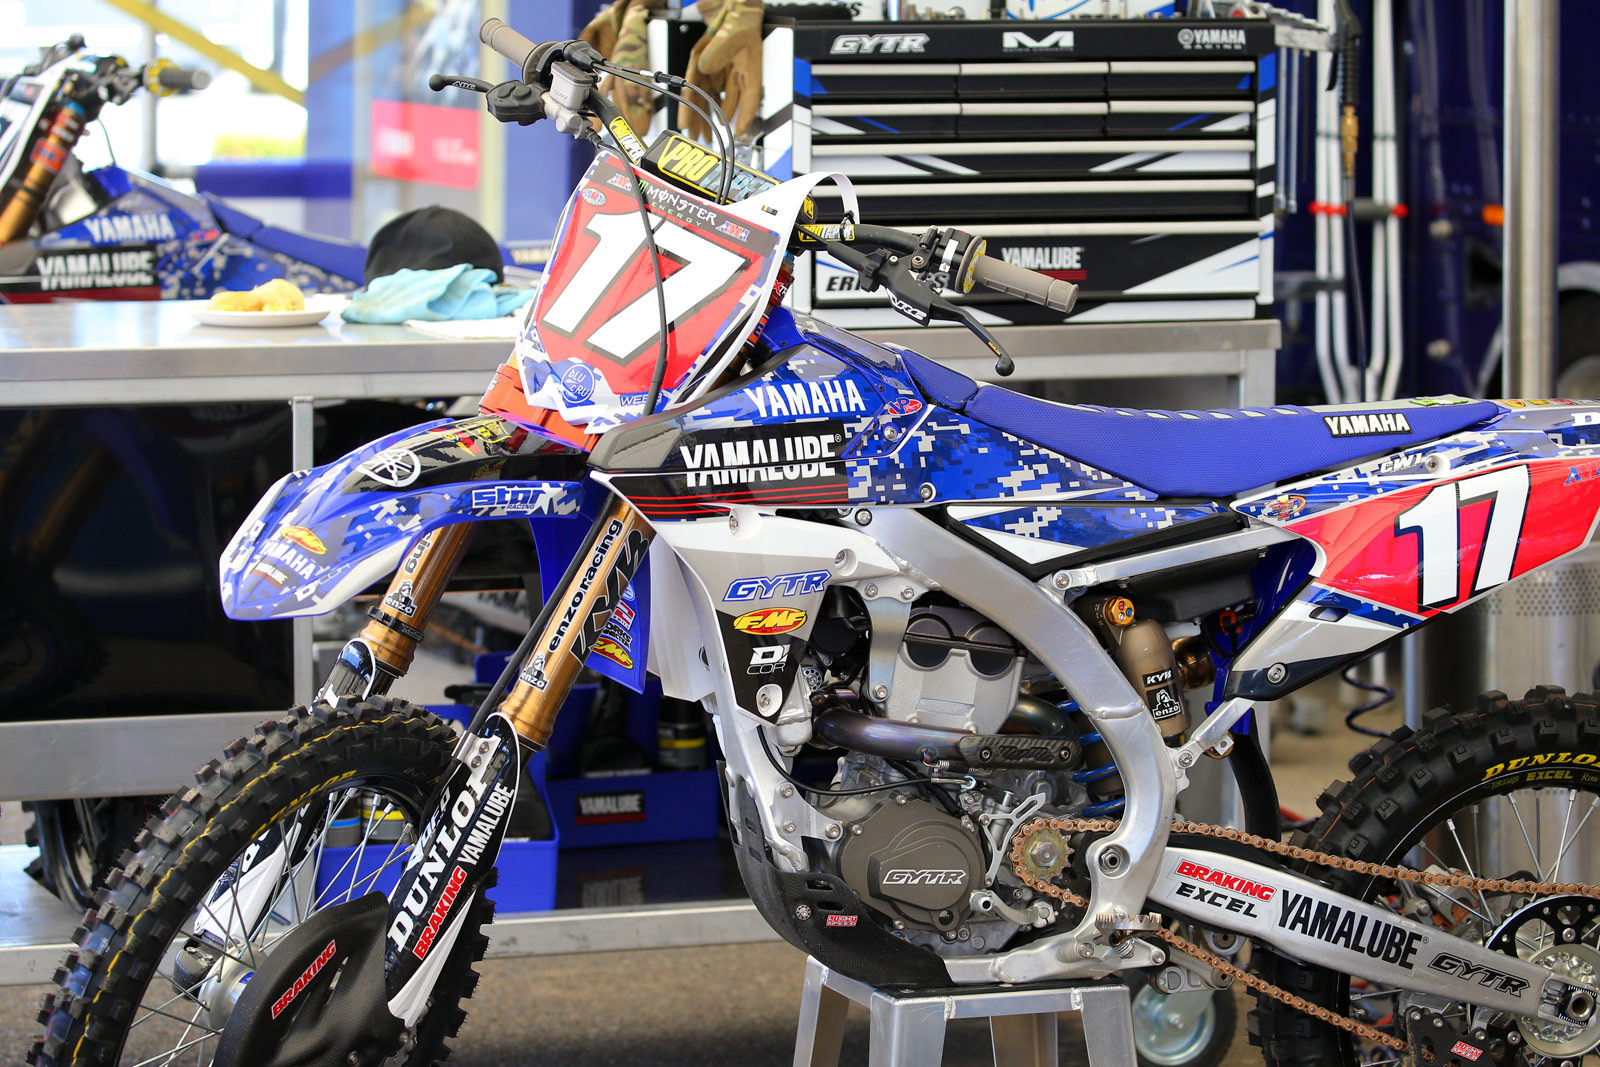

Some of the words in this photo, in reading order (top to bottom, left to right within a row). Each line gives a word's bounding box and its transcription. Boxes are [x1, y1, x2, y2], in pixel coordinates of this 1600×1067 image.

[830, 33, 931, 54] GYTR
[1193, 29, 1246, 44] YAMAHA
[83, 213, 176, 243] YAMAHA
[651, 203, 702, 227] ENERGY
[37, 252, 154, 290] YAMALUBE
[1002, 247, 1082, 269] YAMALUBE
[540, 207, 750, 366] 17
[743, 380, 866, 418] YAMAHA
[1325, 413, 1411, 435] YAMAHA
[680, 434, 836, 488] YAMALUBE
[1396, 464, 1531, 612] 17
[259, 540, 316, 580] YAMAHA
[722, 570, 832, 602] GYTR
[386, 596, 413, 614] enzo
[734, 609, 807, 635] FMF
[1147, 671, 1172, 685] KYB
[1155, 704, 1180, 718] enzo
[1526, 770, 1574, 782] EXCEL
[580, 794, 642, 815] YAMALUBE
[457, 781, 515, 866] YAMALUBE
[882, 869, 967, 885] GYTR
[1175, 860, 1277, 903] BRAKING
[413, 866, 467, 961] BRAKING
[1174, 882, 1258, 919] EXCEL
[1275, 889, 1424, 970] YAMALUBE
[271, 939, 337, 1021] BRAKING
[1427, 951, 1532, 998] GYTR
